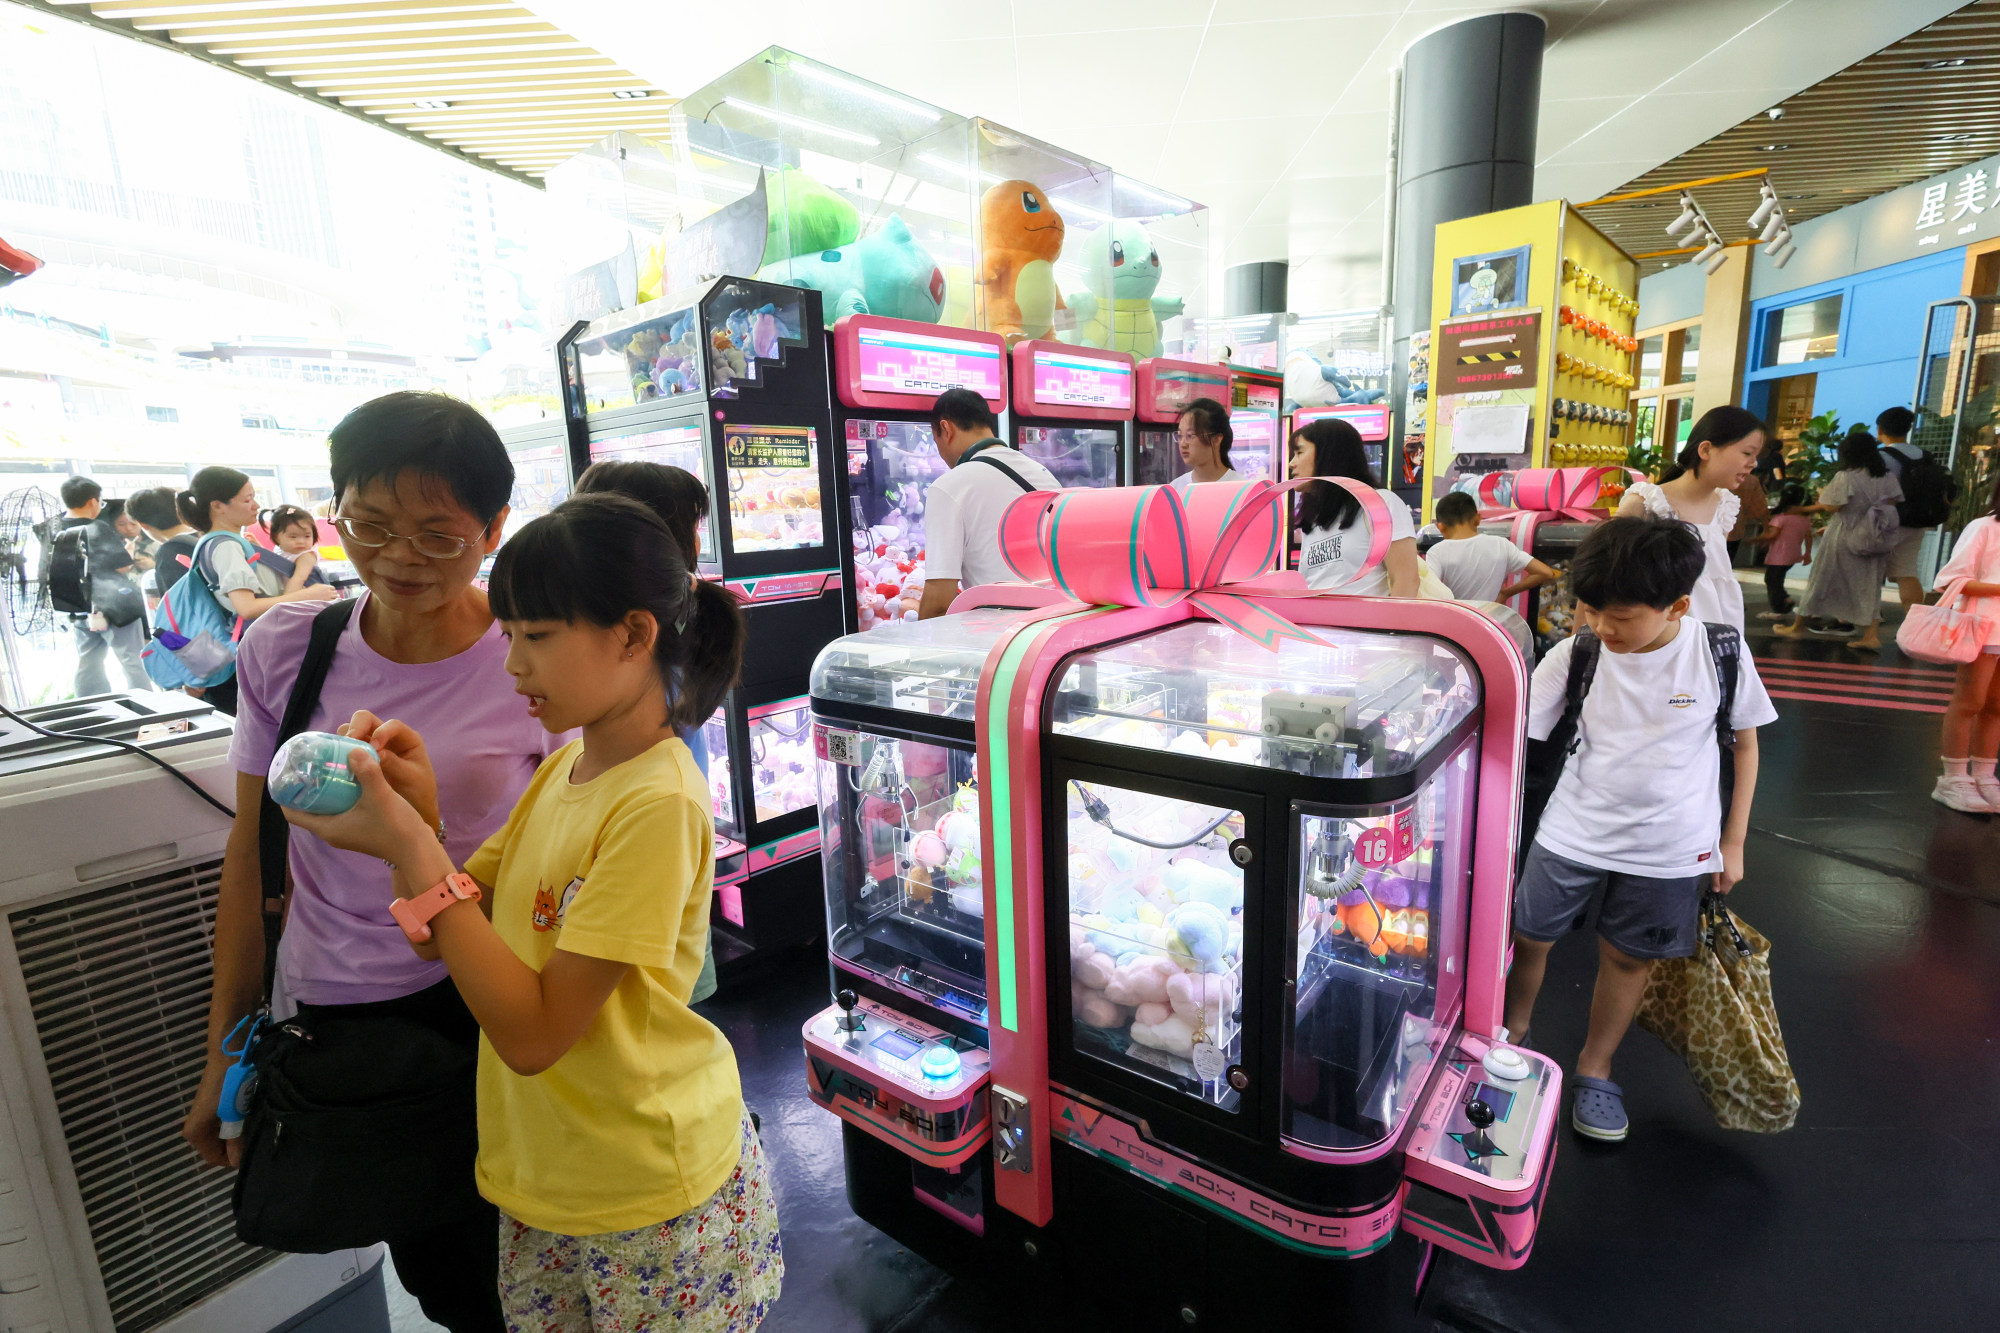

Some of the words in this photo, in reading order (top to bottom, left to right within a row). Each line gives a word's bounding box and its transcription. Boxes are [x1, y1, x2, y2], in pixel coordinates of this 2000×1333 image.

[1915, 165, 2000, 231] 星美
[910, 351, 956, 368] TOY
[877, 362, 987, 384] INVADERS
[1069, 369, 1100, 383] TOY
[1063, 393, 1105, 402] CATCHER
[877, 426, 887, 436] 33
[1307, 549, 1341, 566] GIRBAUD
[1362, 838, 1387, 863] 16
[881, 1009, 903, 1022] TOY
[906, 1020, 931, 1034] BOX
[844, 1078, 889, 1111] TOY
[1110, 1134, 1164, 1168] TOY
[1177, 1167, 1237, 1203] BOX
